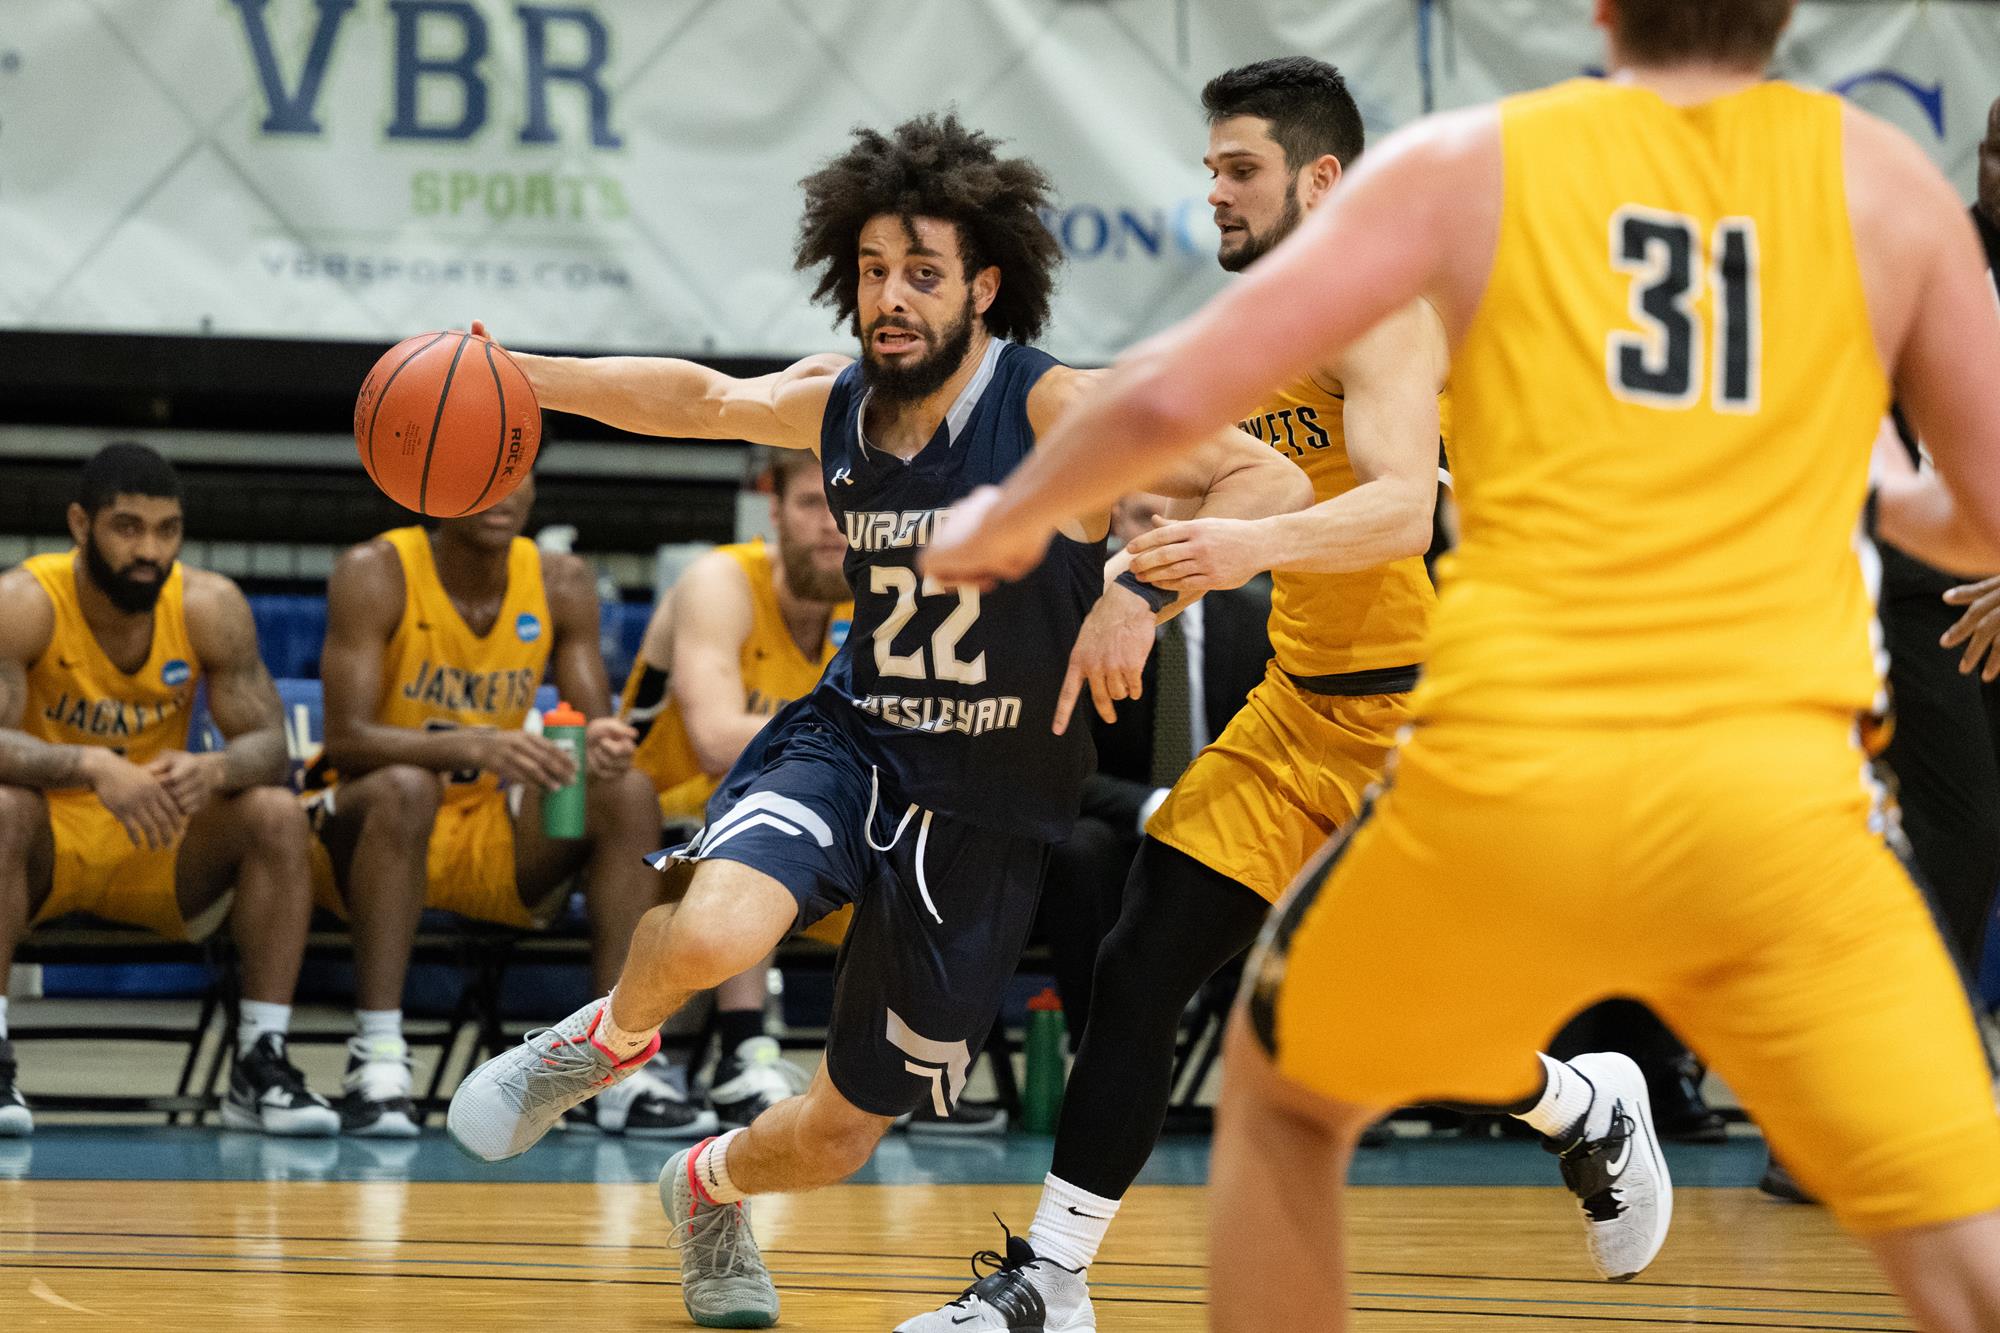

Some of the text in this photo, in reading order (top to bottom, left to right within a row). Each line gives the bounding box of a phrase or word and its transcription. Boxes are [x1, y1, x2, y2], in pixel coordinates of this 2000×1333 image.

[229, 0, 624, 148] VBR
[411, 169, 630, 219] SPORTS
[1606, 204, 1760, 414] 31
[501, 427, 522, 478] ROCK
[869, 565, 987, 685] 22
